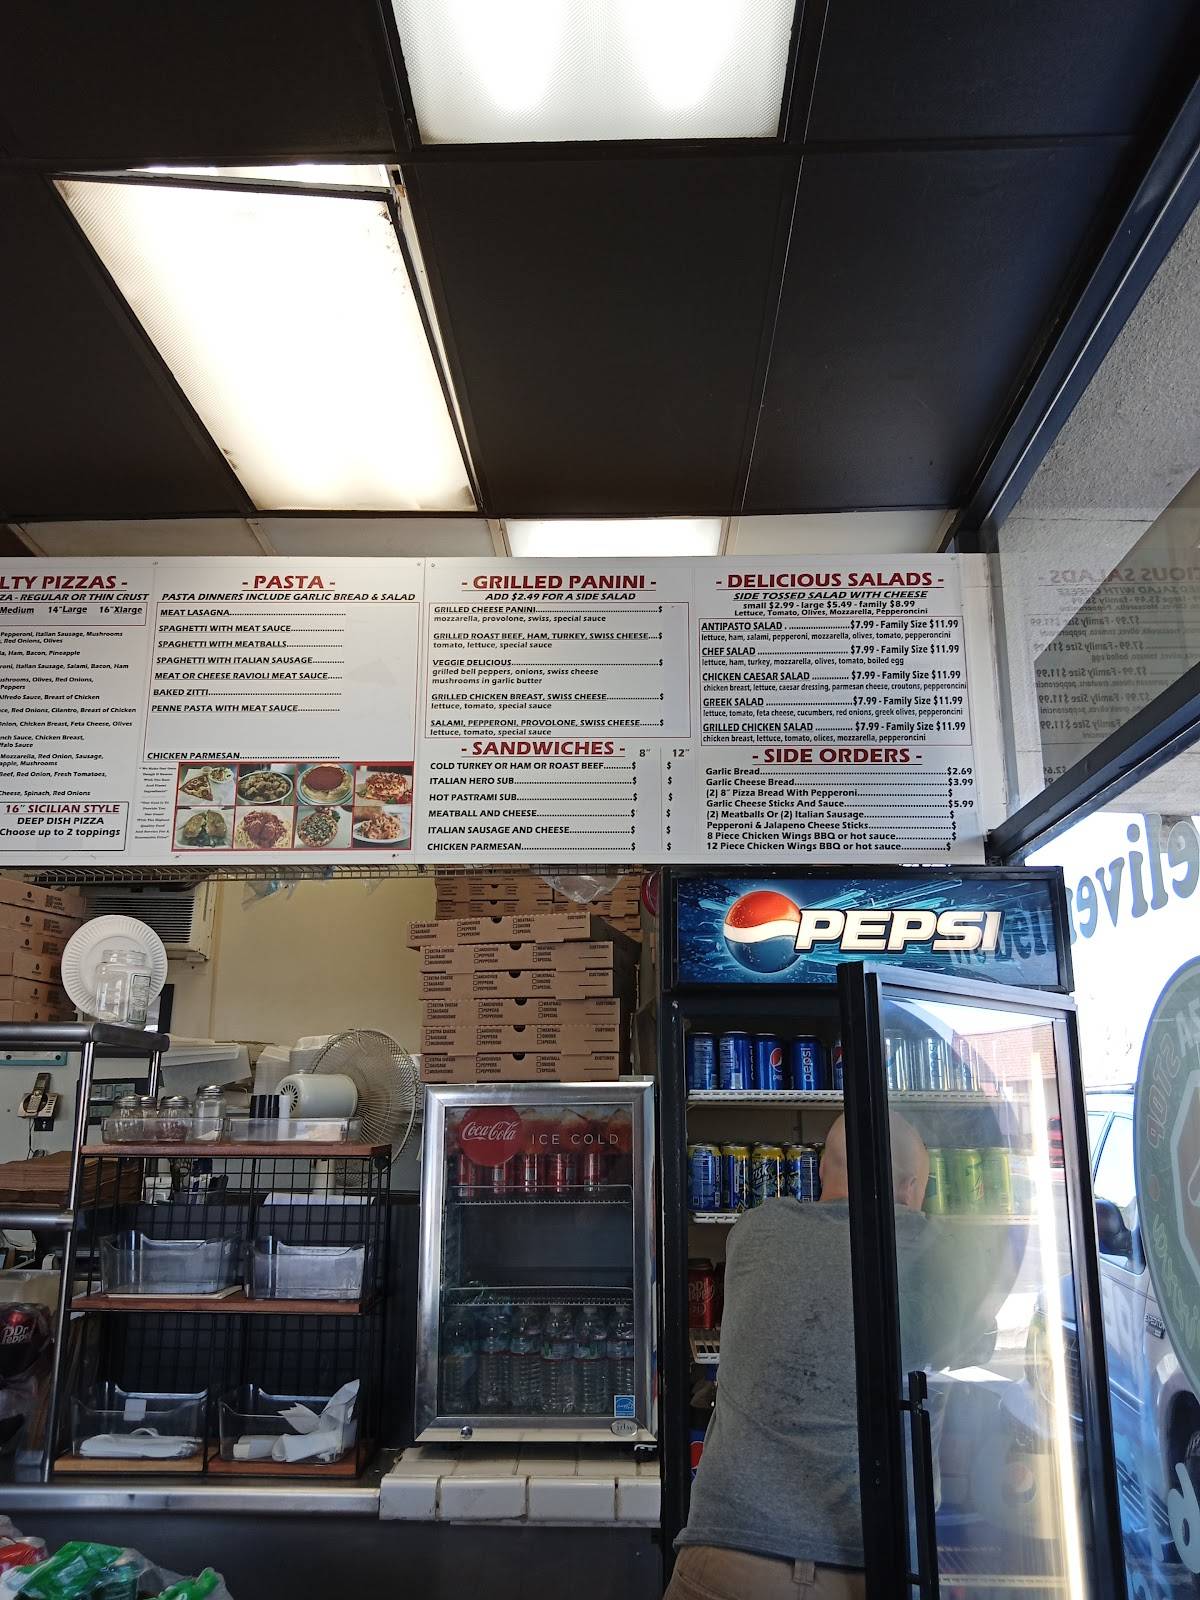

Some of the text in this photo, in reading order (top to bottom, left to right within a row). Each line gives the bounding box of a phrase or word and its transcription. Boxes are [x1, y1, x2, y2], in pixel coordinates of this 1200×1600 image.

[41, 576, 116, 589] PIZZAS
[254, 576, 323, 589] PASTA
[473, 575, 645, 589] GRILLED PANINI
[727, 573, 933, 587] DELICIOUS SALADS
[761, 591, 806, 599] TOSSED
[807, 591, 847, 599] SALAD
[849, 591, 881, 599] WITH
[882, 591, 928, 599] CHEESE
[743, 601, 766, 609] small
[769, 601, 794, 609] $2.99
[801, 601, 823, 610] large
[859, 601, 886, 610] family
[875, 608, 928, 616] Pepperoncini
[553, 615, 581, 623] special
[701, 620, 959, 630] ANTIPASTO SALAD $7.99 Family Size $11.99
[491, 677, 514, 685] garlic
[702, 671, 961, 681] CHICKEN CAESAR SALAD $7.99 Family Size $11.99
[472, 742, 614, 755] SANDWICHES
[147, 752, 187, 760] CHICKEN
[764, 749, 910, 763] SIDE ORDERS
[430, 762, 454, 770] COLD
[458, 762, 491, 770] TURKEY
[494, 762, 507, 770] OR
[509, 762, 531, 770] HAM
[533, 762, 546, 770] OR
[548, 762, 577, 770] ROAST
[429, 777, 466, 785] ITALIAN
[468, 777, 494, 785] HERO
[27, 804, 80, 812] SICILIAN
[83, 804, 120, 812] STYLE
[0, 828, 35, 836] Choose
[53, 828, 64, 836] to
[66, 828, 72, 836] 2
[75, 828, 121, 837] toppings
[707, 832, 712, 840] 8
[715, 832, 739, 840] Piece
[741, 832, 779, 840] Chicken
[782, 832, 811, 842] Wings
[813, 832, 835, 840] BBQ
[850, 832, 866, 840] hot
[795, 910, 1002, 951] PEPSI
[801, 1048, 815, 1082] pepsi
[461, 1121, 518, 1141] Coca-Cola
[532, 1133, 619, 1145] ICE COLD
[14, 1325, 29, 1336] Dr
